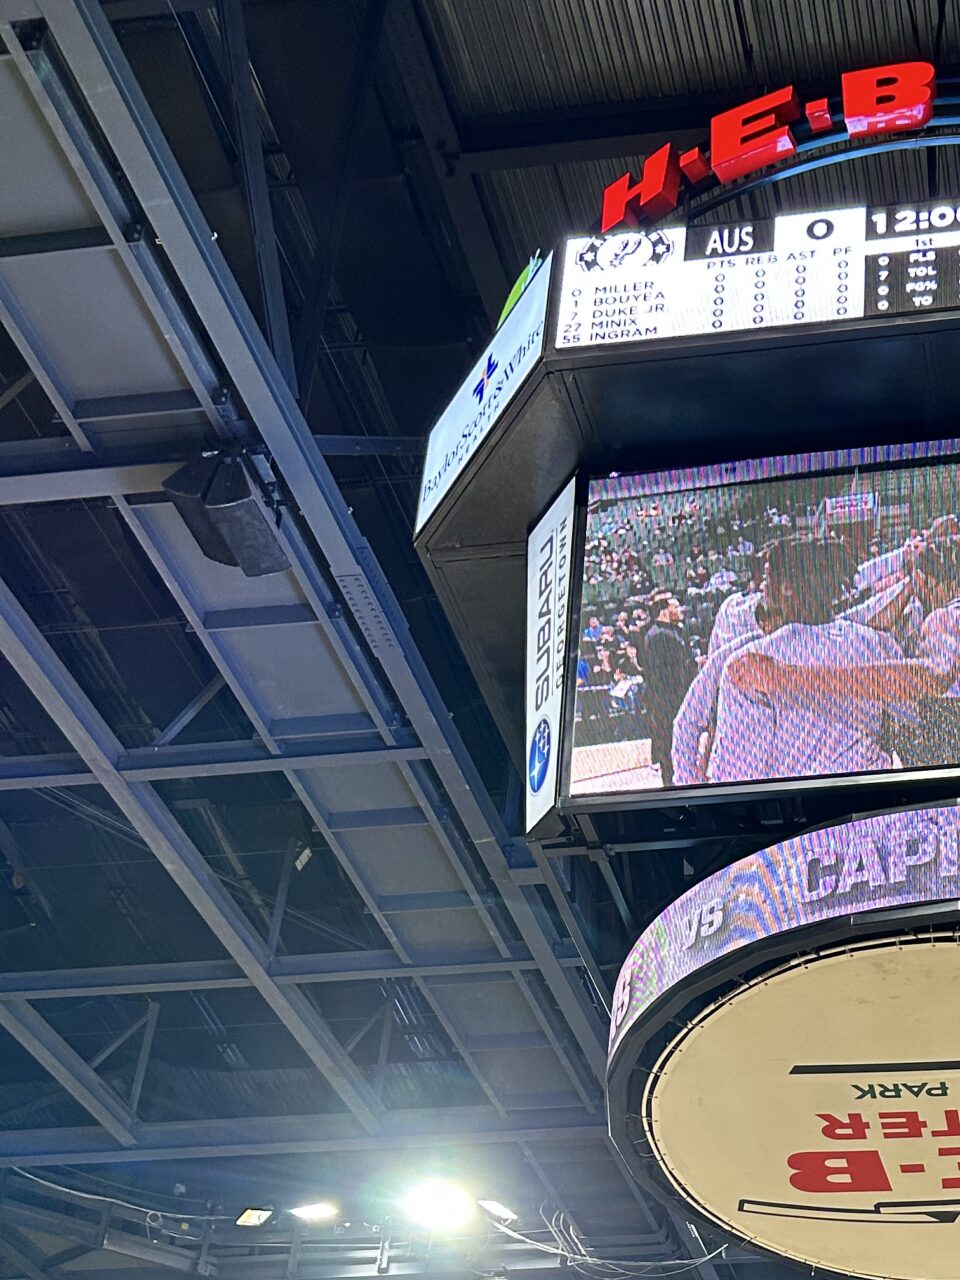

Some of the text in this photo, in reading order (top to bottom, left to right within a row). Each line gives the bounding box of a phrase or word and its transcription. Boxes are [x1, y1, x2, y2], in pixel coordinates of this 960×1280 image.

[706, 218, 834, 256] AUS 0
[914, 238, 934, 247] 1st
[707, 247, 853, 270] PTS REB AST PF
[877, 256, 890, 266] 0
[909, 250, 937, 263] FLS
[878, 271, 889, 281] 7
[907, 266, 937, 278] TOL
[594, 281, 655, 295] MILLER
[877, 285, 890, 296] 0
[593, 291, 665, 306] BOUYEA
[877, 300, 890, 311] 0
[912, 295, 934, 307] TO
[571, 312, 578, 320] 7
[592, 305, 639, 320] DUKE
[562, 318, 638, 333] 27 MINIX
[562, 326, 657, 345] 55 INGRAM
[457, 402, 500, 465] HEALTH
[555, 515, 569, 691] GEORGETOWN
[535, 536, 555, 713] SUBARU
[681, 900, 724, 949] VS
[853, 1078, 949, 1101] PARK
